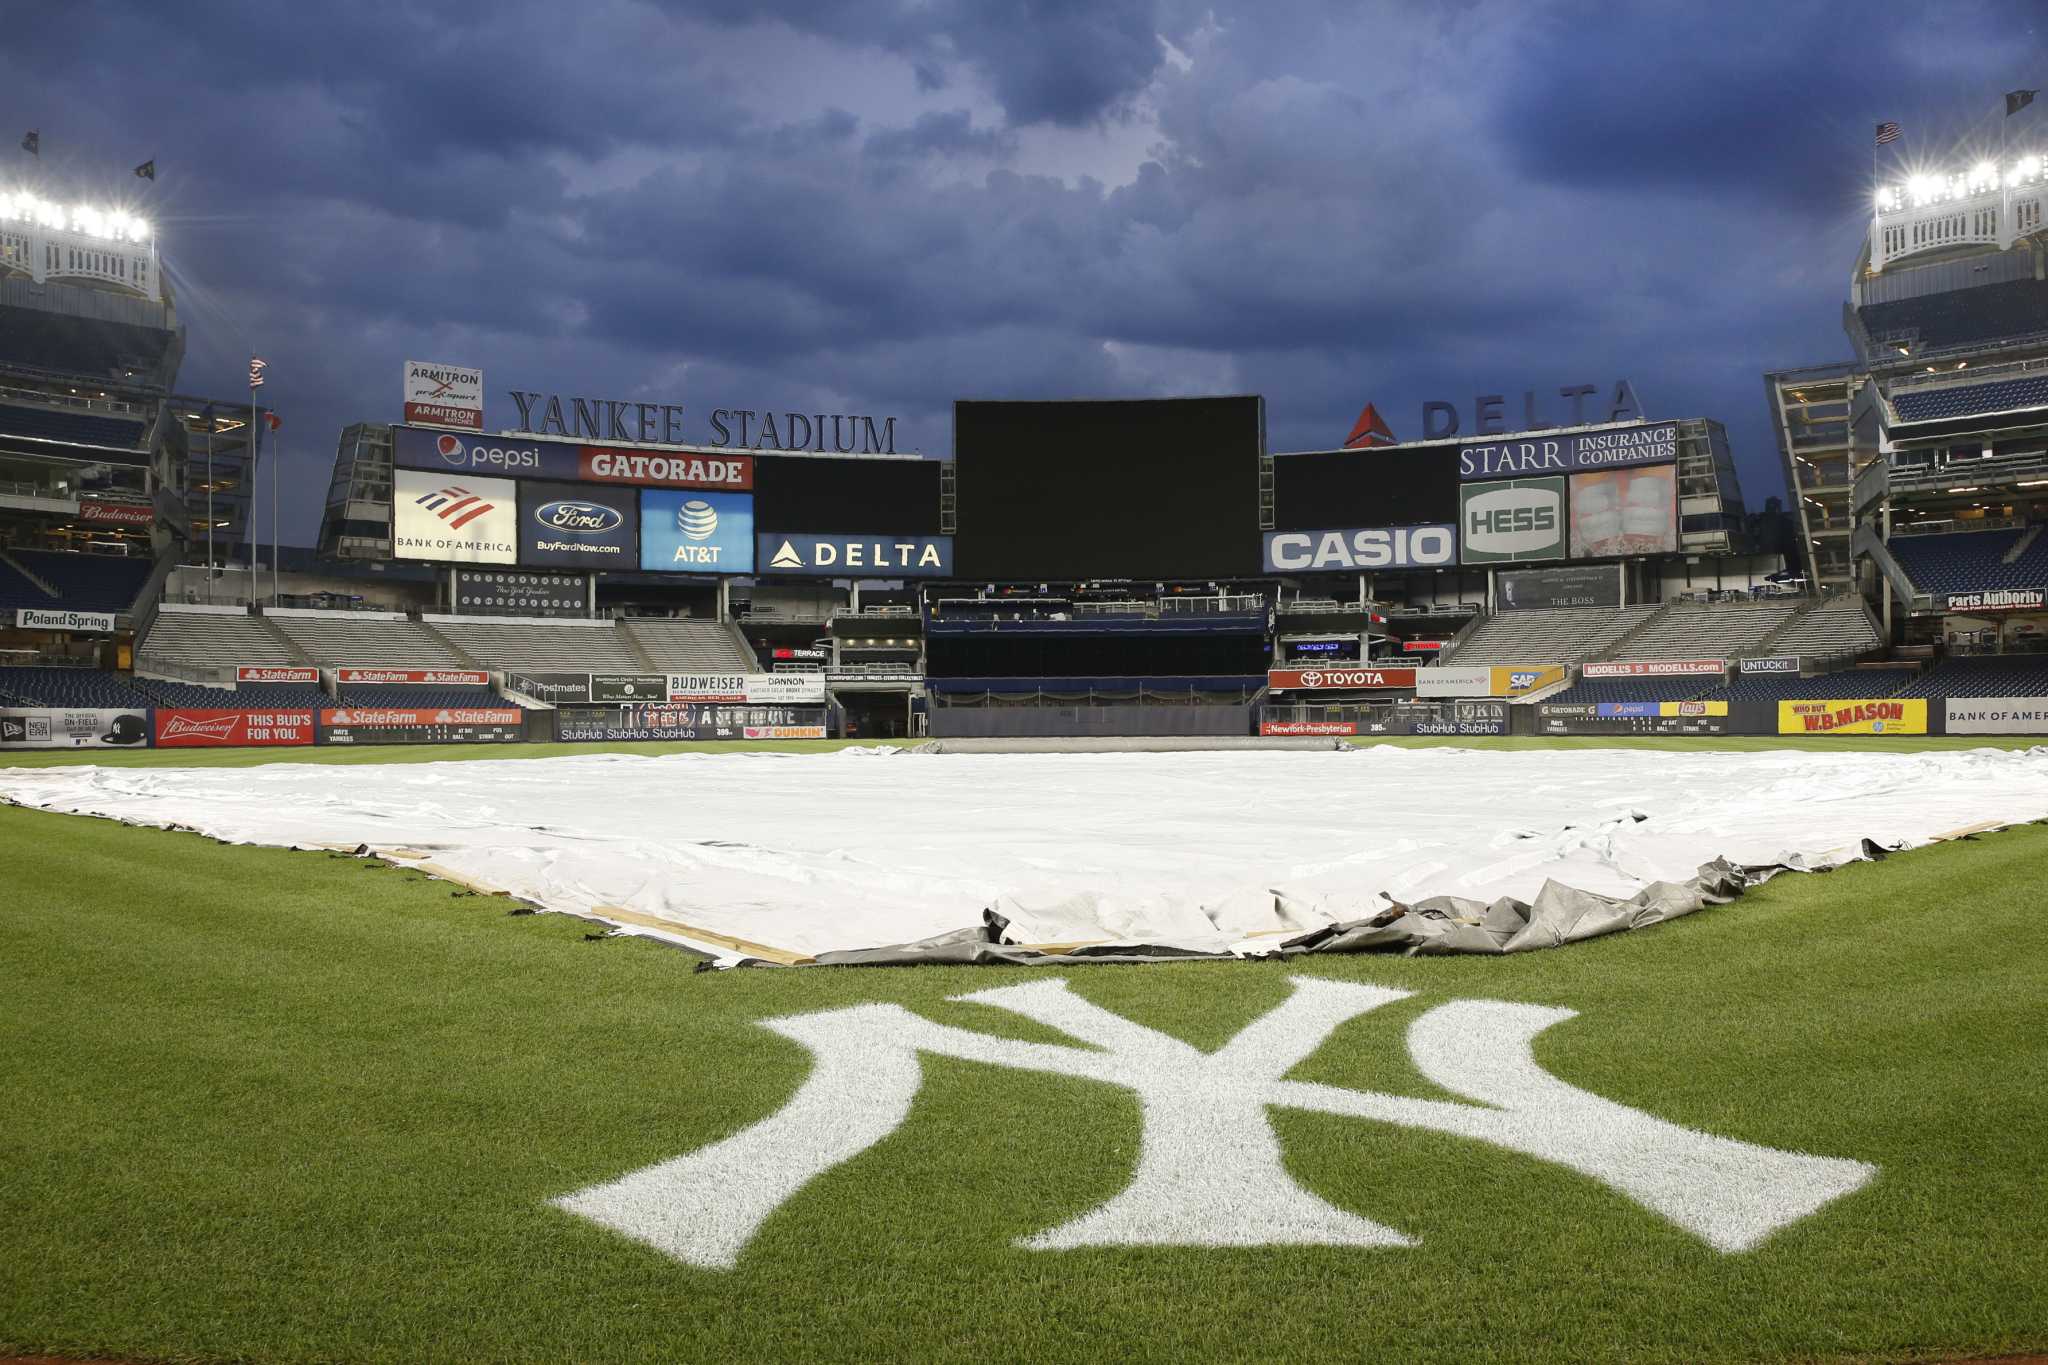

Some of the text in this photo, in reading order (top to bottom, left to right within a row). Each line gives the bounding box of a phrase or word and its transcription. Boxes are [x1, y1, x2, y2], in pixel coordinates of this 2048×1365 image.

[411, 368, 479, 385] ARMITRON
[414, 405, 475, 420] ARMITRON
[1422, 379, 1646, 441] DELTA
[509, 391, 897, 455] YANKEE STADIUM
[1578, 427, 1676, 451] INSURANCE
[472, 445, 540, 470] pepsi
[1460, 441, 1567, 476] STARR
[1578, 442, 1676, 465] COMPANIES
[591, 454, 743, 483] GATORADE
[81, 505, 152, 521] Budweiser
[553, 504, 605, 529] Ford
[1471, 506, 1555, 535] HESS
[397, 537, 513, 553] BANK OF AMERICA
[537, 541, 620, 555] BuyFordNow.com
[1270, 527, 1452, 570] CASIO
[674, 545, 722, 563] AT&T
[815, 542, 942, 568] DELTA
[1551, 596, 1595, 606] THE BOSS
[1948, 590, 2043, 607] Parts Authority
[23, 610, 109, 630] Poland Spring
[1587, 665, 1631, 674] MODELL'S
[1649, 663, 1719, 673] MODELLS.com
[1743, 660, 1788, 671] UNTUCKit
[672, 677, 744, 689] BUDWEISER
[768, 677, 805, 685] DANNON
[1325, 672, 1384, 685] TOYOTA
[1511, 674, 1536, 687] SAP
[537, 683, 587, 693] Postmates
[1792, 704, 1826, 712] WHO BUT
[248, 714, 311, 726] THIS BUD'S
[1949, 712, 1986, 721] BANK
[1991, 712, 2008, 721] OF
[29, 721, 48, 729] NEW
[167, 720, 232, 733] Budweiser
[1417, 723, 1499, 734] StubHub StubHub
[248, 728, 300, 740] FOR YOU.
[561, 727, 695, 740] StubHub StubHub StubHub
